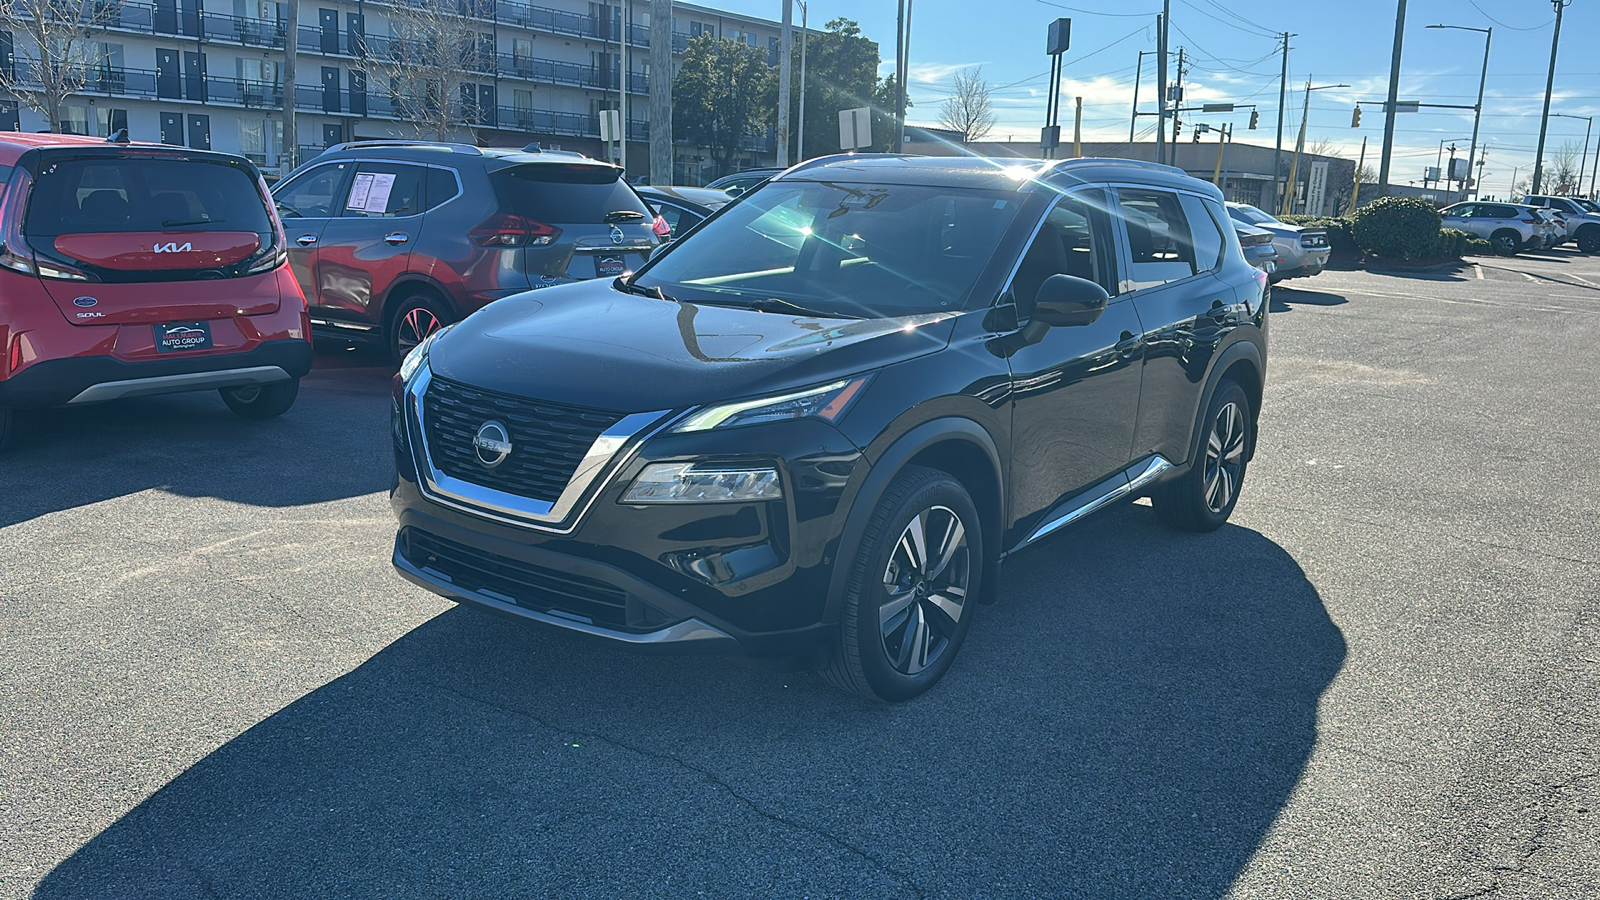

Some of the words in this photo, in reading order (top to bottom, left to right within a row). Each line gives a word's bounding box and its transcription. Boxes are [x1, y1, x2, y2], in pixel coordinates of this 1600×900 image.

[153, 242, 192, 253] KIA
[162, 332, 201, 340] HALLMARK
[181, 337, 205, 345] GROUP
